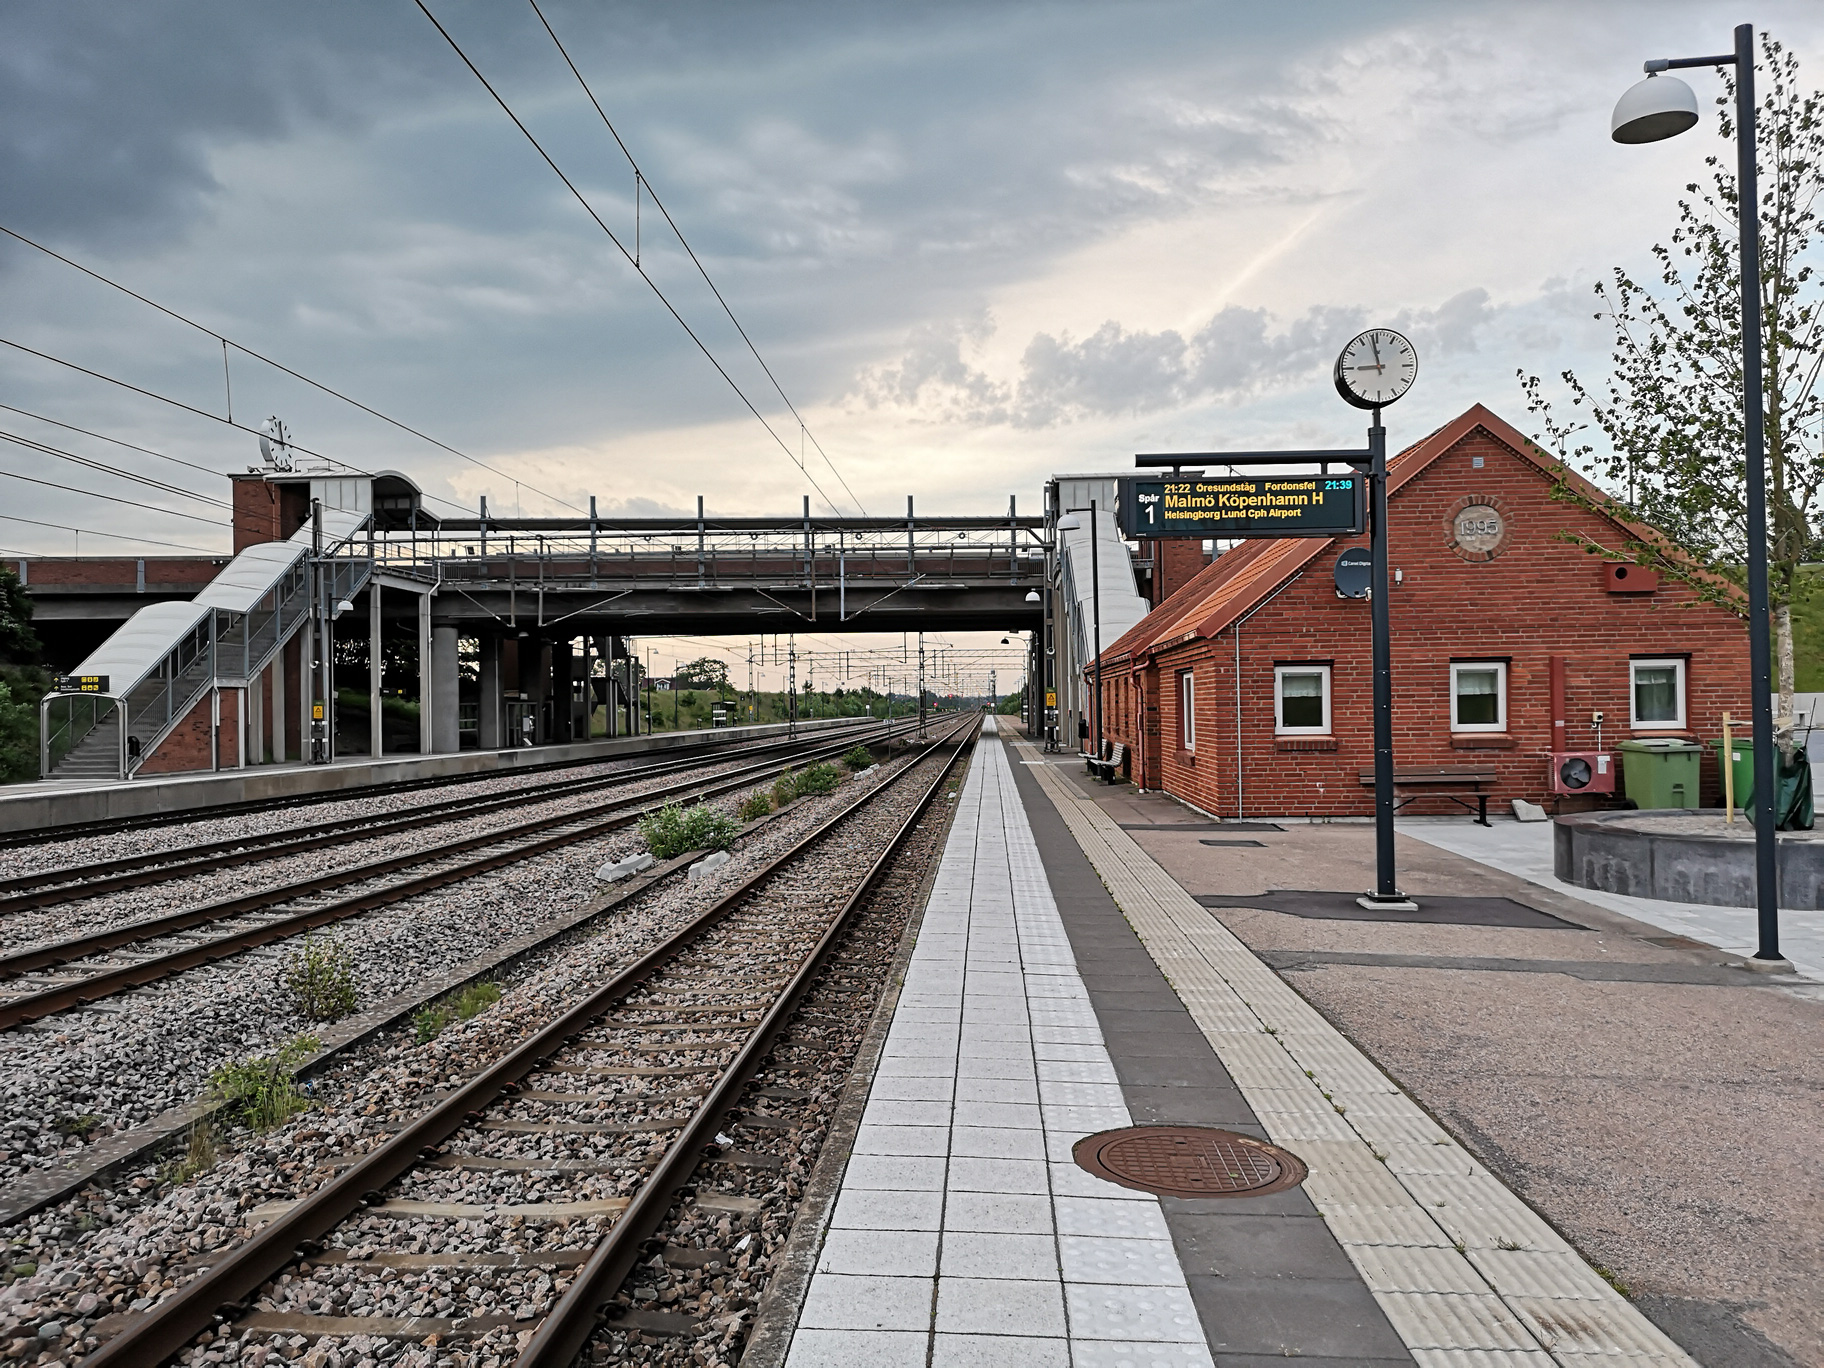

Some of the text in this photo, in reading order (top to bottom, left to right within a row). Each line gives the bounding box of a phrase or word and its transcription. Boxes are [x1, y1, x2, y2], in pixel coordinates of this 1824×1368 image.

[1164, 481, 1316, 493] 21:22 Öresundståg Fordonsfel
[1325, 480, 1352, 490] 21:39
[1138, 494, 1160, 504] Spår
[1164, 491, 1324, 509] Malmö Köpenhamn H
[1145, 505, 1154, 524] 1
[1164, 508, 1302, 520] Helsingborg Lund Cph Airport
[1461, 520, 1498, 534] 1995
